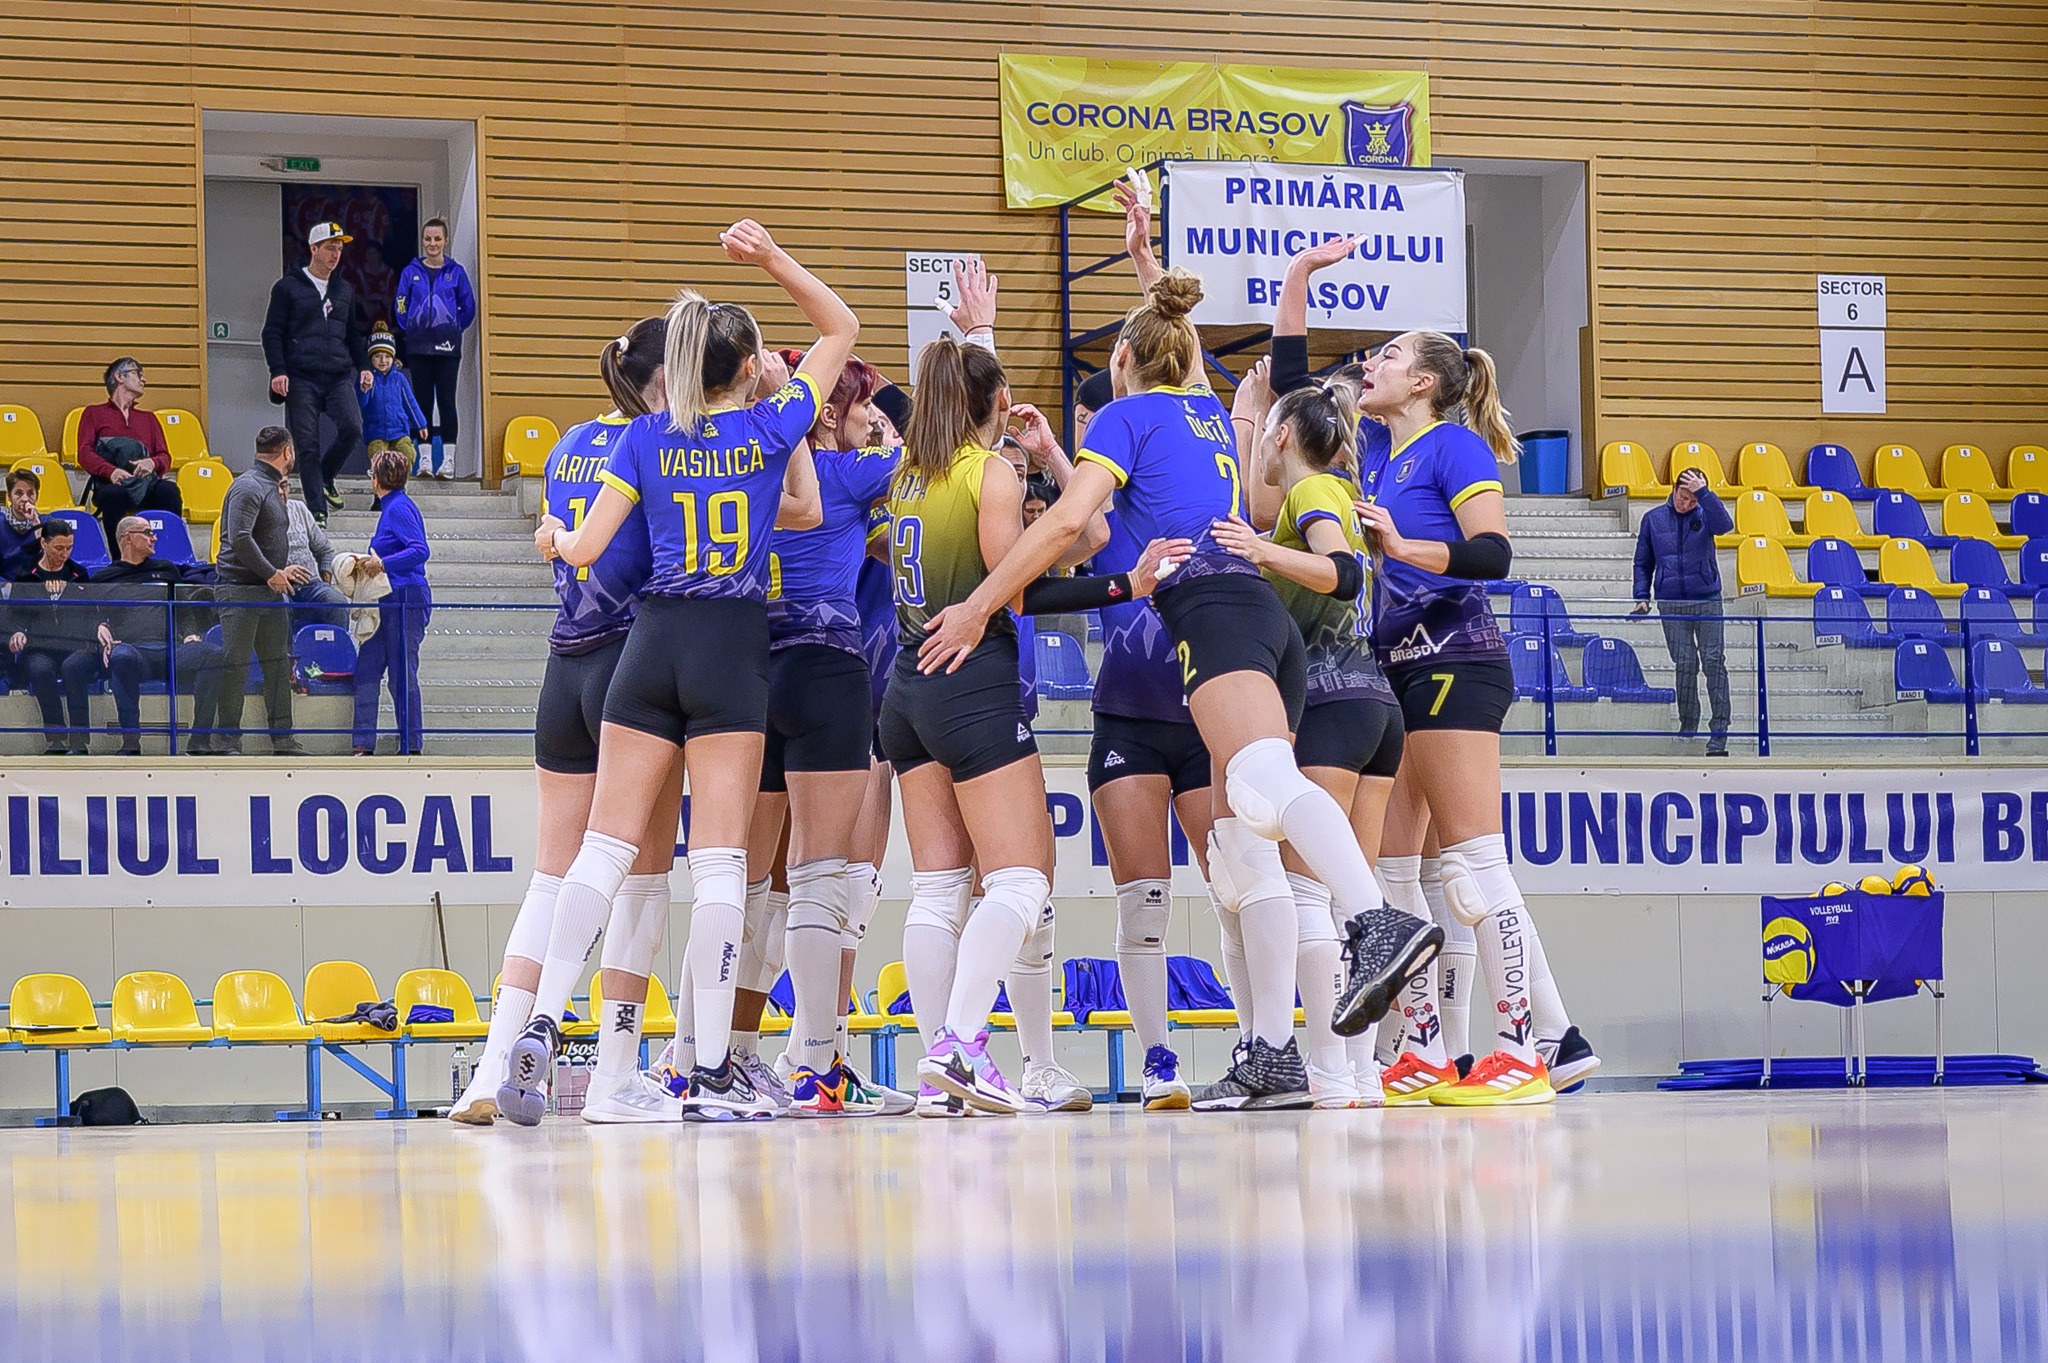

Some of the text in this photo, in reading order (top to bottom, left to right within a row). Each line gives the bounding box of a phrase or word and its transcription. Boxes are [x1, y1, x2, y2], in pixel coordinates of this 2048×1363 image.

[1026, 101, 1331, 150] CORONA BRAȘOV
[291, 160, 315, 171] EXIT
[1028, 140, 1055, 161] Un
[1061, 141, 1110, 162] club.
[1116, 143, 1135, 164] O
[1358, 154, 1400, 164] CORONA
[1225, 174, 1405, 212] PRIMĂRIA
[938, 281, 951, 301] 5
[1246, 277, 1391, 320] BRȘOV
[1820, 281, 1884, 296] SECTOR
[1847, 303, 1858, 321] 6
[1838, 347, 1876, 393] A
[658, 438, 765, 477] VASILICĂ
[672, 490, 749, 576] 19
[1177, 640, 1198, 686] 2
[1429, 673, 1455, 716] 7
[1104, 756, 1126, 768] PEAK
[0, 794, 513, 876] ILIUL LOCAL
[1501, 791, 1957, 865] UNICIPIULUI
[614, 1003, 638, 1035] PEAK
